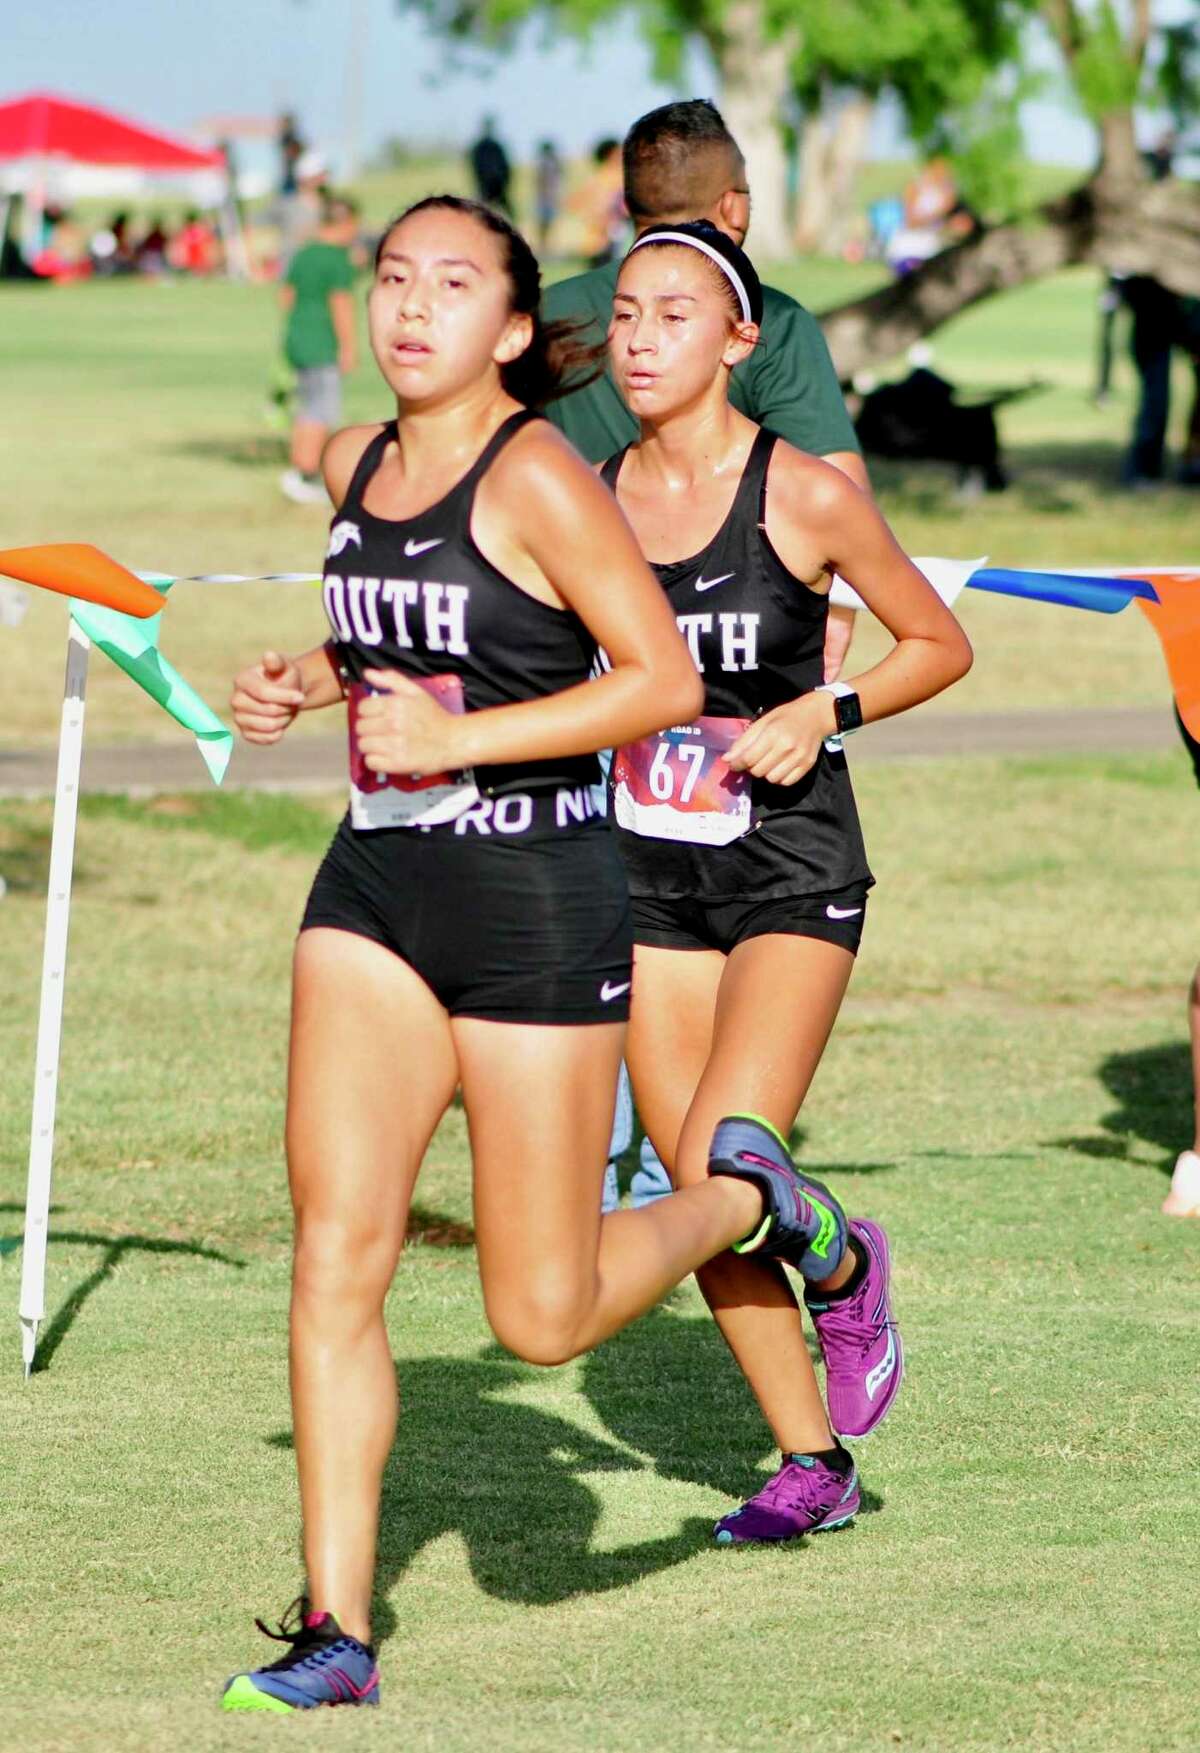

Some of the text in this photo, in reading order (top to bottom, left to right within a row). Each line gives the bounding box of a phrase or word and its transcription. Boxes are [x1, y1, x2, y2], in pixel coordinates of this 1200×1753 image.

[323, 574, 469, 655] OUTH
[676, 612, 760, 673] TH
[649, 742, 705, 803] 67
[421, 793, 533, 835] RO
